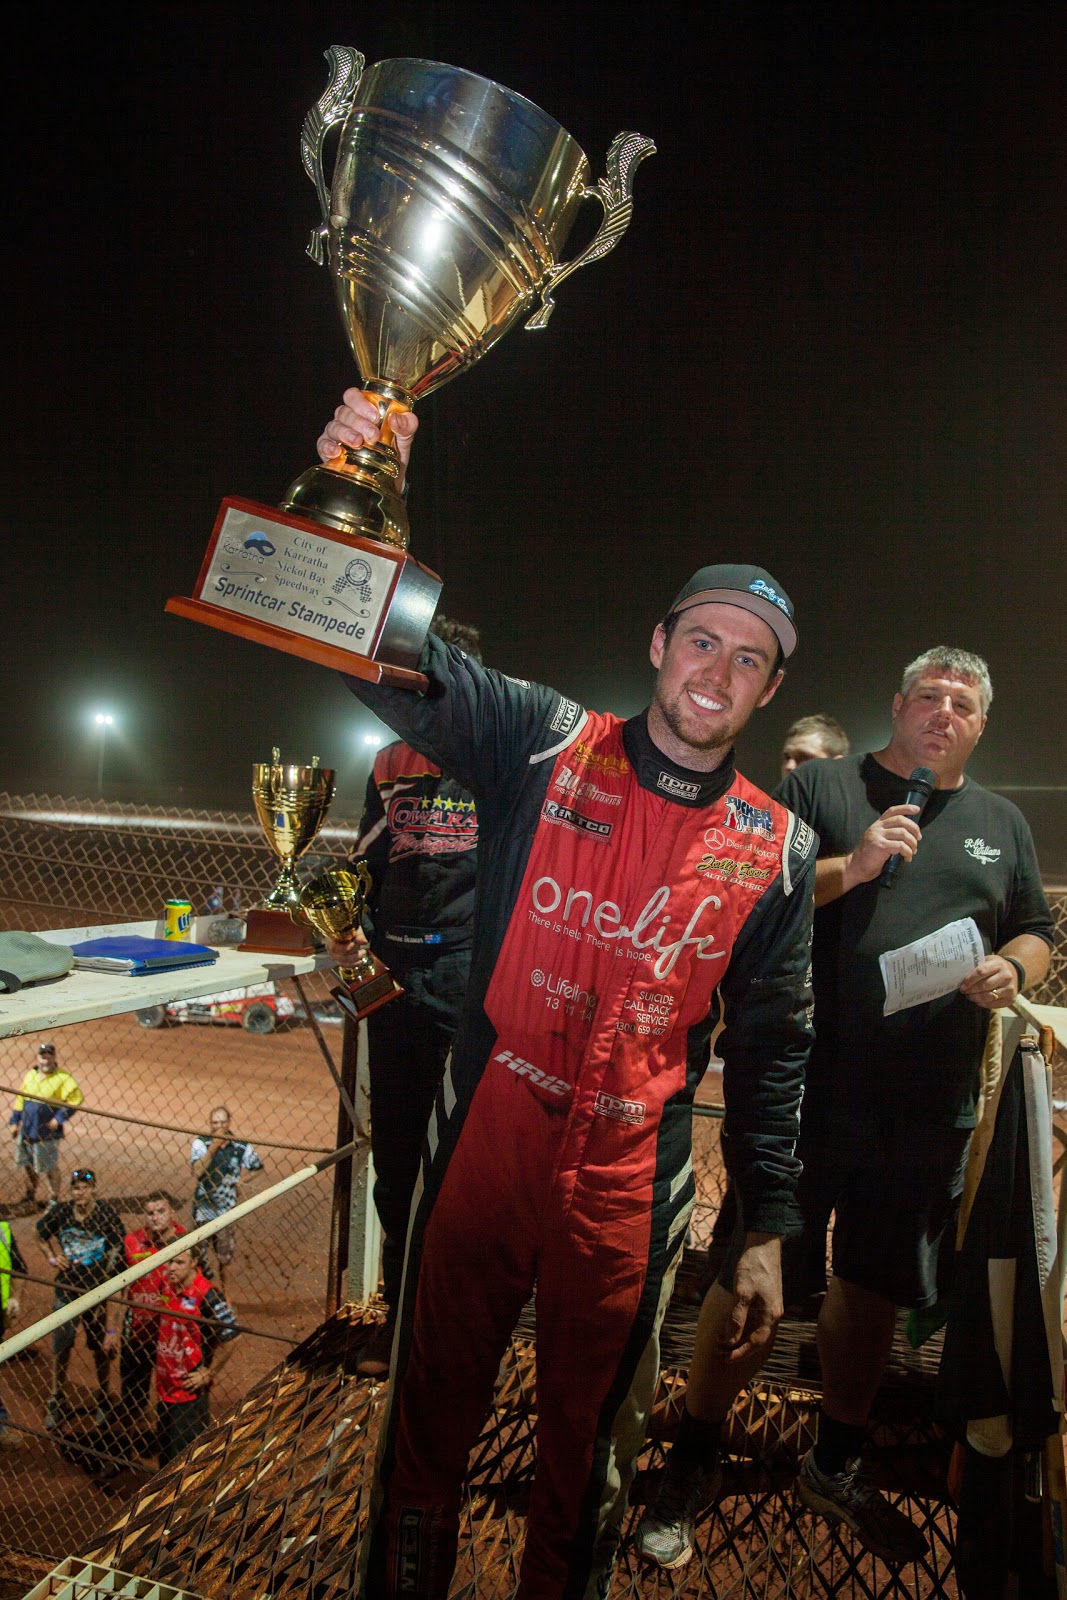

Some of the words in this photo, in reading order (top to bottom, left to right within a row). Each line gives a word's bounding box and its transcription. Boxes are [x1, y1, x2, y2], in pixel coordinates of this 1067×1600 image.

[294, 536, 312, 551] City
[316, 546, 328, 555] of
[284, 547, 329, 569] Karratha
[276, 560, 307, 577] Nickol
[308, 571, 326, 586] Bay
[273, 574, 321, 598] Speedway
[215, 576, 286, 613] Sprintcar
[288, 601, 366, 640] Stampede
[661, 775, 698, 793] rpm
[753, 845, 780, 860] Motors
[696, 853, 737, 877] Jolly
[737, 861, 771, 880] Good
[703, 871, 727, 882] AUTO
[528, 910, 551, 929] There
[552, 921, 561, 932] is
[586, 933, 611, 951] There
[615, 946, 623, 957] is
[626, 948, 654, 963] hope.
[546, 973, 597, 1008] Lifeline
[639, 991, 674, 1006] SUICIDE
[545, 996, 560, 1010] 13
[580, 1009, 593, 1022] 14
[624, 999, 645, 1012] CALL
[648, 1003, 671, 1016] BACK
[615, 1021, 636, 1033] 1300
[637, 1025, 651, 1035] 659
[636, 1013, 669, 1027] SERVICE
[600, 1094, 643, 1116] rpm
